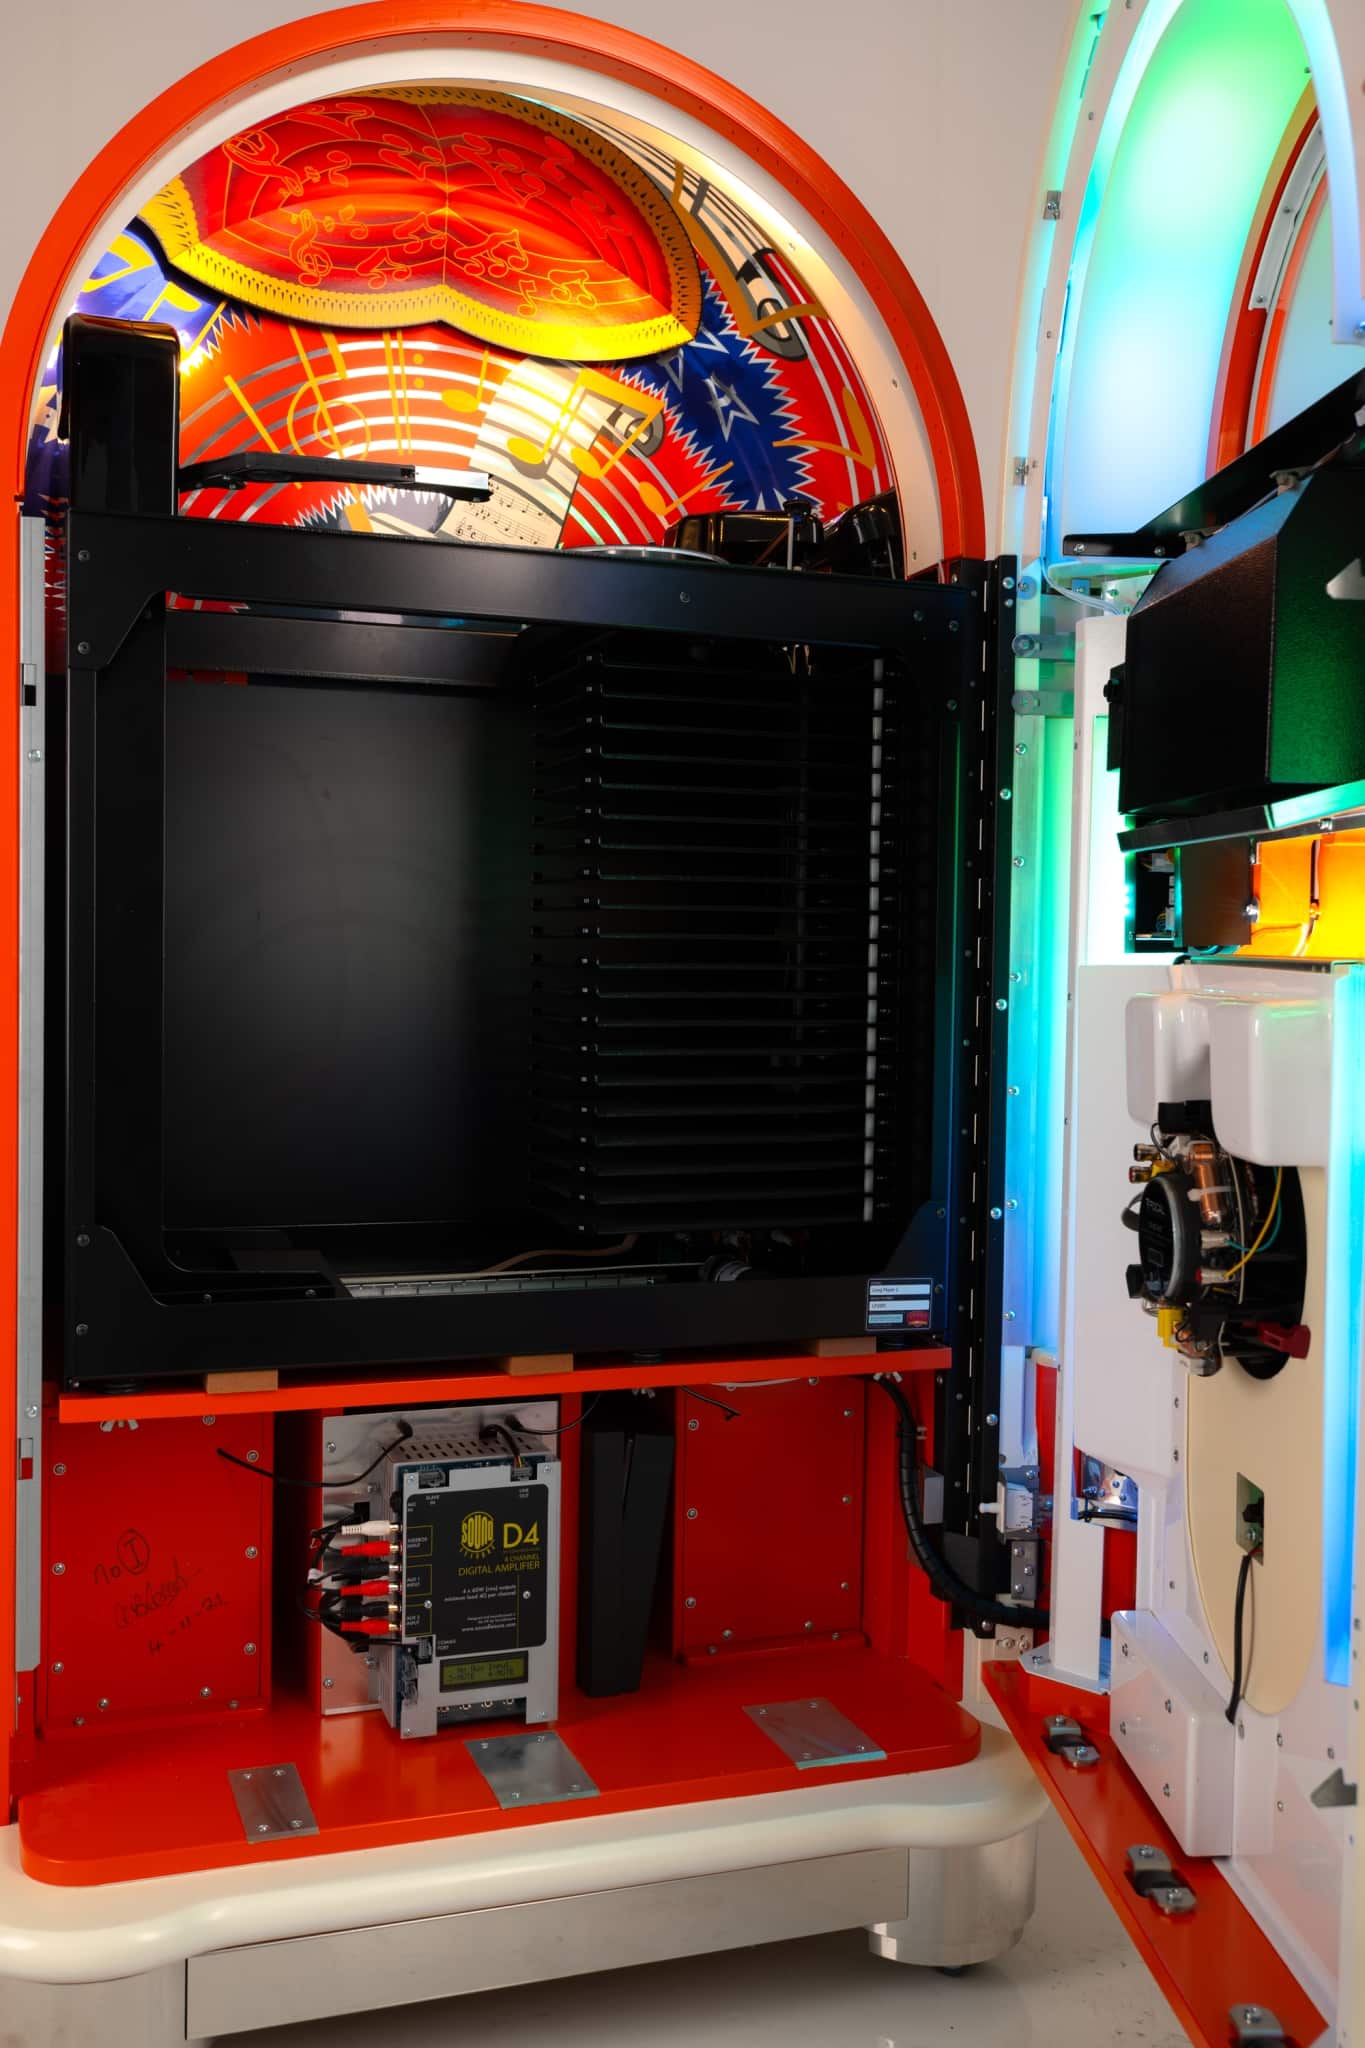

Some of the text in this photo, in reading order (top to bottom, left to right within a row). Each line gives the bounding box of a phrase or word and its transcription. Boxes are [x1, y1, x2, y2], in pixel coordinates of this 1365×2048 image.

[461, 1514, 495, 1550] SOUND
[503, 1520, 541, 1550] D4
[457, 1559, 541, 1577] DIGITAL AMPLIFIER
[511, 1552, 540, 1561] CHANNEL
